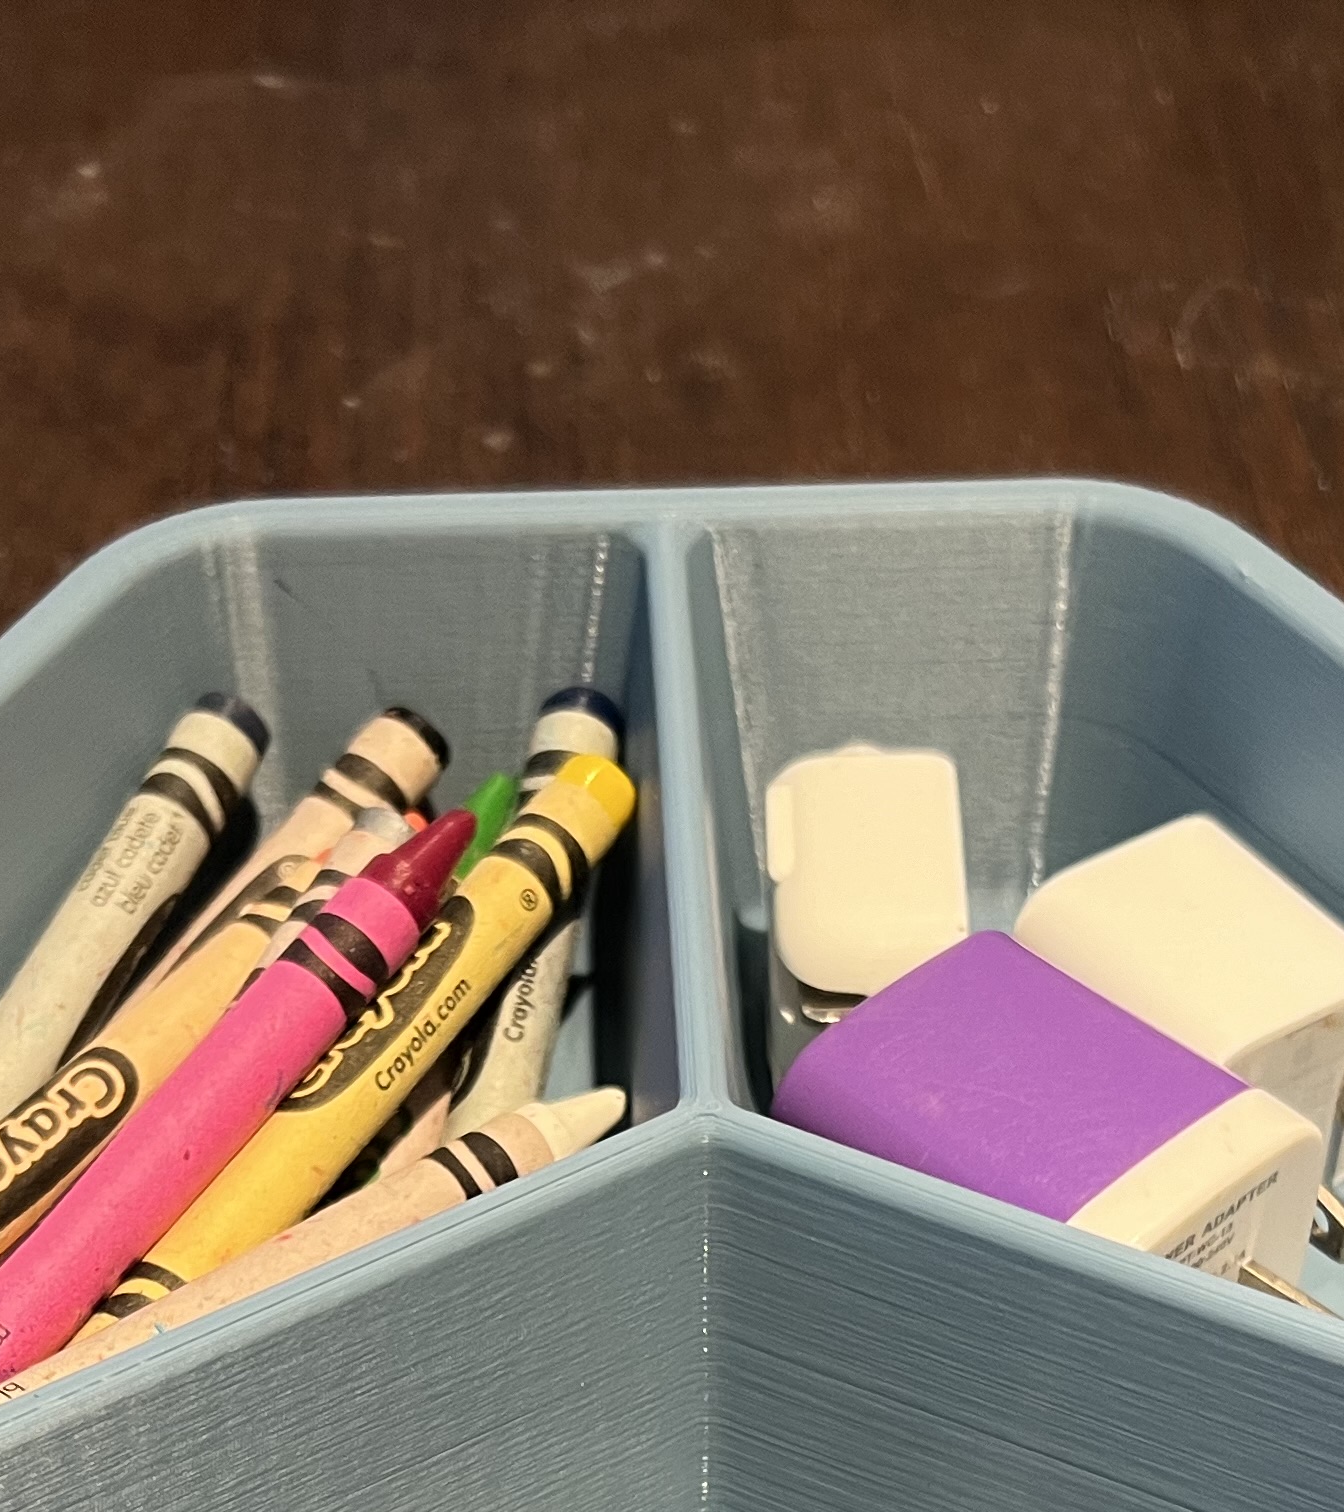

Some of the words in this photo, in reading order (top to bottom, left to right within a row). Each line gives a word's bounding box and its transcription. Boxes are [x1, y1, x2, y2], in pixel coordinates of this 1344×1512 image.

[89, 870, 121, 907] azul
[116, 812, 160, 868] cadete
[374, 978, 471, 1091] Crayola.com
[1201, 1170, 1280, 1238] ADAPTER
